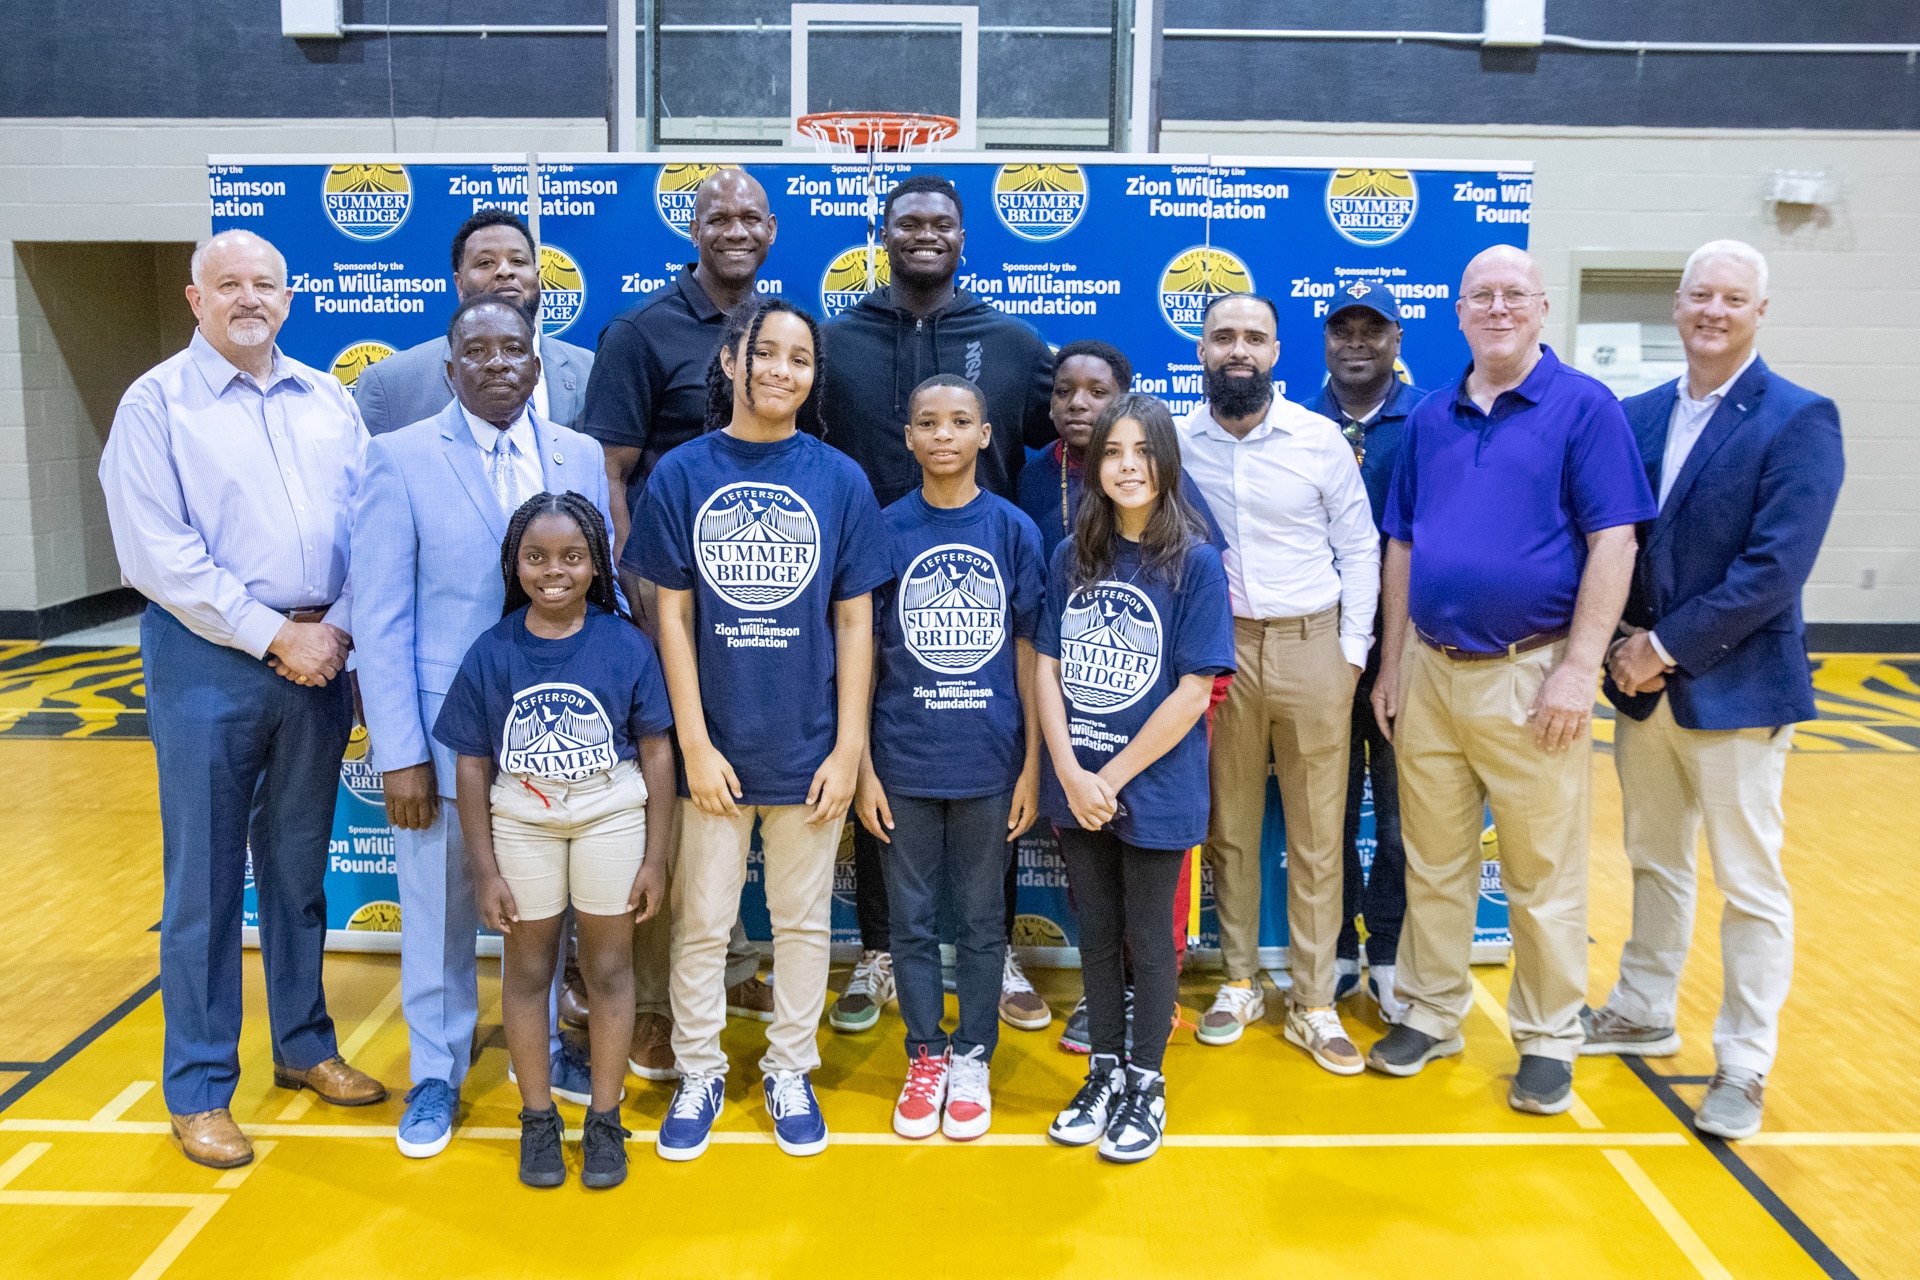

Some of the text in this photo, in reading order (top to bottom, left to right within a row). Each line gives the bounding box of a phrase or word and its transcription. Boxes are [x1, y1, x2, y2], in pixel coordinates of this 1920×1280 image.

[218, 166, 228, 175] by
[229, 166, 243, 174] the
[548, 164, 558, 174] by
[559, 164, 574, 172] the
[884, 164, 895, 174] by
[897, 164, 911, 172] the
[1219, 167, 1230, 177] by
[1231, 168, 1246, 176] the
[209, 176, 286, 196] liamson
[449, 175, 618, 195] Zion Williamson
[786, 175, 832, 195] Zion
[1126, 175, 1289, 199] Zion Williamson
[1453, 181, 1497, 202] Zion
[210, 196, 264, 216] ation
[328, 194, 406, 209] SUMMER
[662, 194, 696, 208] SUM
[811, 197, 886, 216] Founda
[1000, 194, 1081, 209] SUMMER
[1332, 200, 1411, 214] SUMMER
[337, 209, 400, 222] BRIDGE
[1007, 209, 1073, 222] BRIDGE
[1150, 198, 1265, 220] Foundation
[1476, 204, 1531, 224] Found
[1339, 214, 1404, 228] BRIDGE
[841, 250, 886, 264] JEFFERS
[1181, 252, 1234, 266] JEFFERSON
[333, 262, 404, 272] Sponsored by the
[1002, 263, 1077, 273] Sponsored by the
[1334, 267, 1407, 277] Sponsored by the
[291, 273, 446, 293] Zion Williamson
[621, 272, 665, 293] Zion
[958, 273, 1121, 294] Zion Williamson
[1291, 277, 1335, 298] Zion
[315, 294, 424, 313] Foundation
[541, 293, 579, 306] MER
[826, 294, 865, 307] SUM
[1165, 295, 1206, 308] SUM
[542, 307, 572, 320] DGE
[1172, 309, 1205, 322] BRI
[346, 346, 393, 360] JEFFERSO
[1167, 362, 1204, 373] Sponsor
[722, 490, 792, 506] JEFFERSON
[705, 544, 809, 564] SUMMER
[921, 553, 990, 572] JEFFERSON
[717, 564, 799, 583] BRIDGE
[1081, 590, 1144, 613] JEFFERSON
[908, 611, 1002, 629] SUMMER
[715, 623, 800, 637] Zion Williamson
[727, 636, 787, 648] Foundation
[915, 630, 994, 646] BRIDGE
[1061, 641, 1149, 675] SUMMER
[1064, 662, 1137, 691] BRIDGE
[913, 686, 937, 698] Zion
[516, 693, 586, 714] JEFFERSON
[925, 698, 986, 709] Foundation
[1071, 716, 1092, 725] ponsored
[1071, 724, 1128, 744] Williamson
[1071, 736, 1114, 753] ndation
[510, 748, 609, 773] SUMMER
[343, 763, 383, 776] SUM
[351, 776, 384, 789] BRI
[348, 825, 389, 835] Sponsored
[329, 836, 394, 855] on Willi
[331, 856, 397, 874] Founda
[1018, 849, 1066, 868] illia
[1016, 869, 1069, 887] datio
[361, 904, 401, 916] JEFFERS
